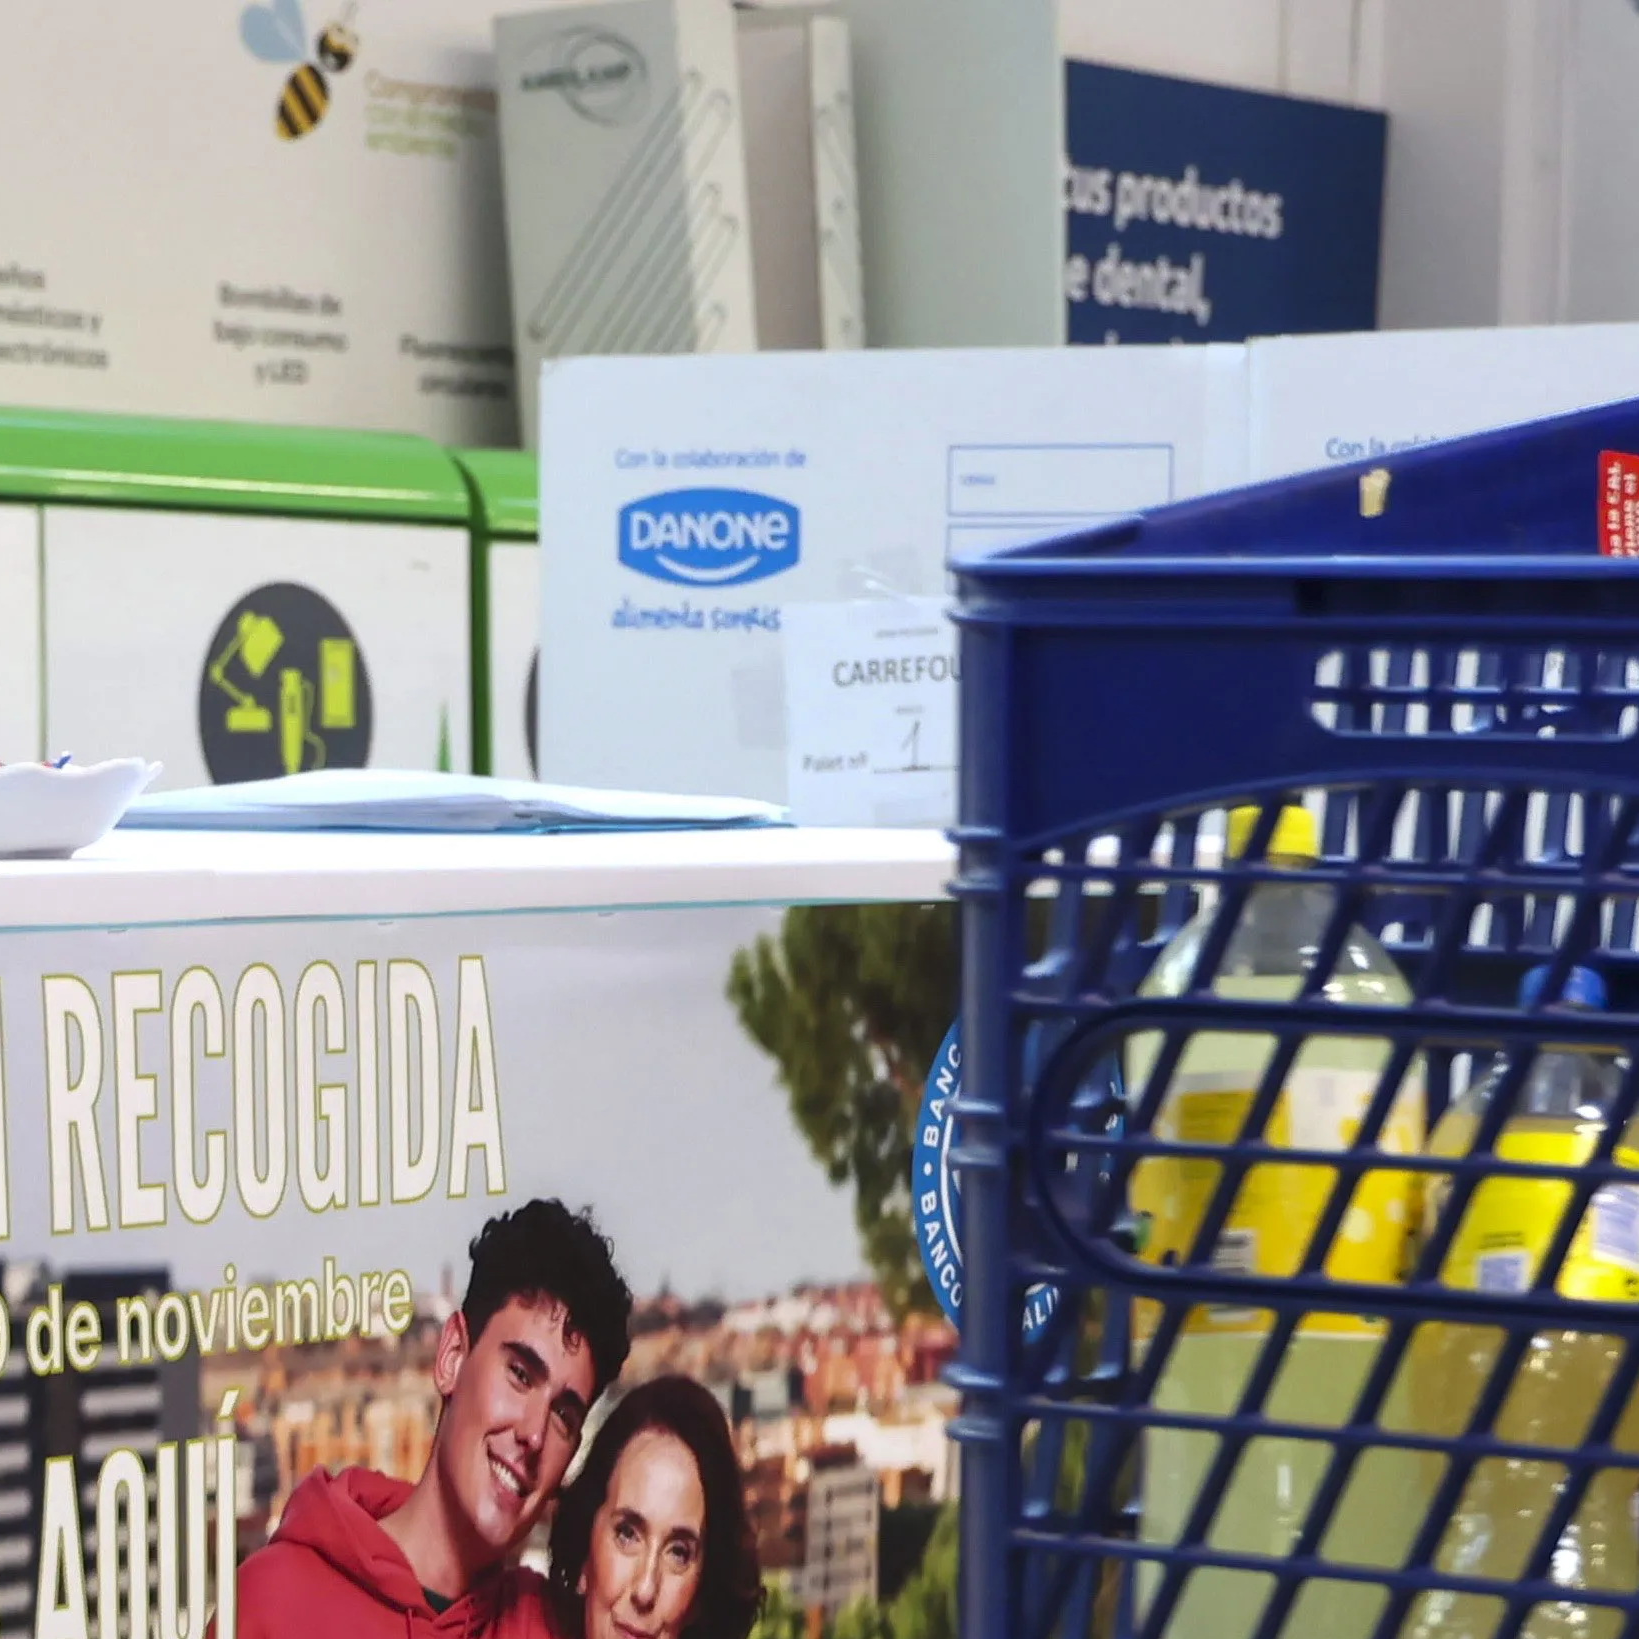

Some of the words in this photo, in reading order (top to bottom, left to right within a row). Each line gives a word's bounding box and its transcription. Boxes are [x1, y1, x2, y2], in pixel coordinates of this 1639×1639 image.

[1114, 164, 1283, 240] productos
[1064, 254, 1091, 302] e
[1093, 242, 1211, 327] dental,
[615, 448, 648, 468] Con
[1325, 436, 1364, 459] Con
[832, 654, 963, 688] CARREFOU
[41, 954, 506, 1236] RECOGIDA
[923, 1043, 962, 1148] BANC
[27, 1284, 102, 1375] de
[117, 1257, 413, 1364] noviembre
